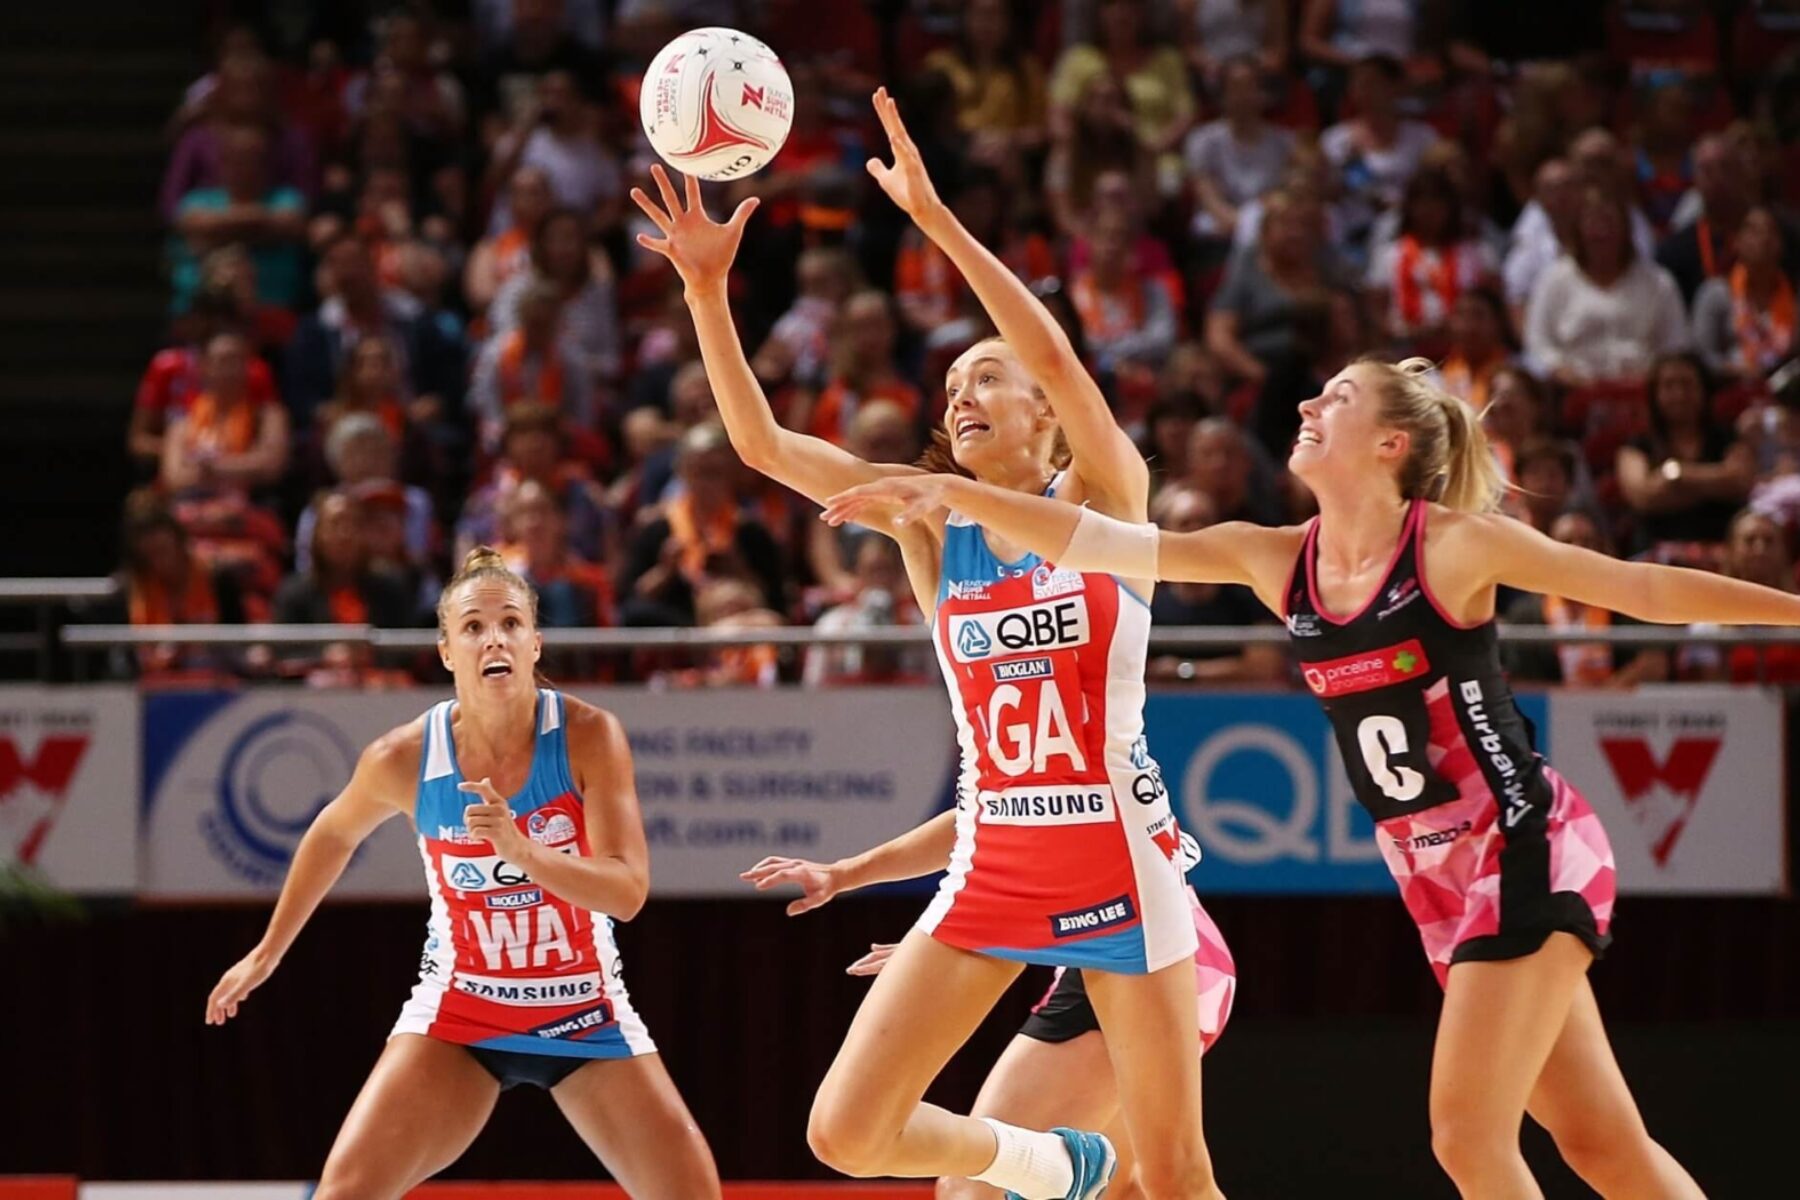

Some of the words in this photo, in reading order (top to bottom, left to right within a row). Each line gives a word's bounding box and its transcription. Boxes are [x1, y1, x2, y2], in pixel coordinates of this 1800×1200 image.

[662, 78, 671, 113] SUPER
[766, 95, 787, 110] SUPER
[961, 591, 992, 601] NETBALL
[1035, 578, 1083, 598] SWIFTS
[996, 602, 1080, 650] QBE
[998, 660, 1046, 679] BIOGLAN
[1326, 658, 1384, 682] priceline
[987, 679, 1087, 777] GA
[1357, 715, 1425, 801] C
[986, 792, 1104, 818] SAMSUNG
[490, 892, 537, 907] BIOGLAN
[1059, 911, 1099, 932] BING
[1099, 902, 1127, 921] LEE
[468, 904, 575, 971] WA
[463, 980, 593, 1001] SAMSUNG
[577, 1010, 604, 1029] LEE
